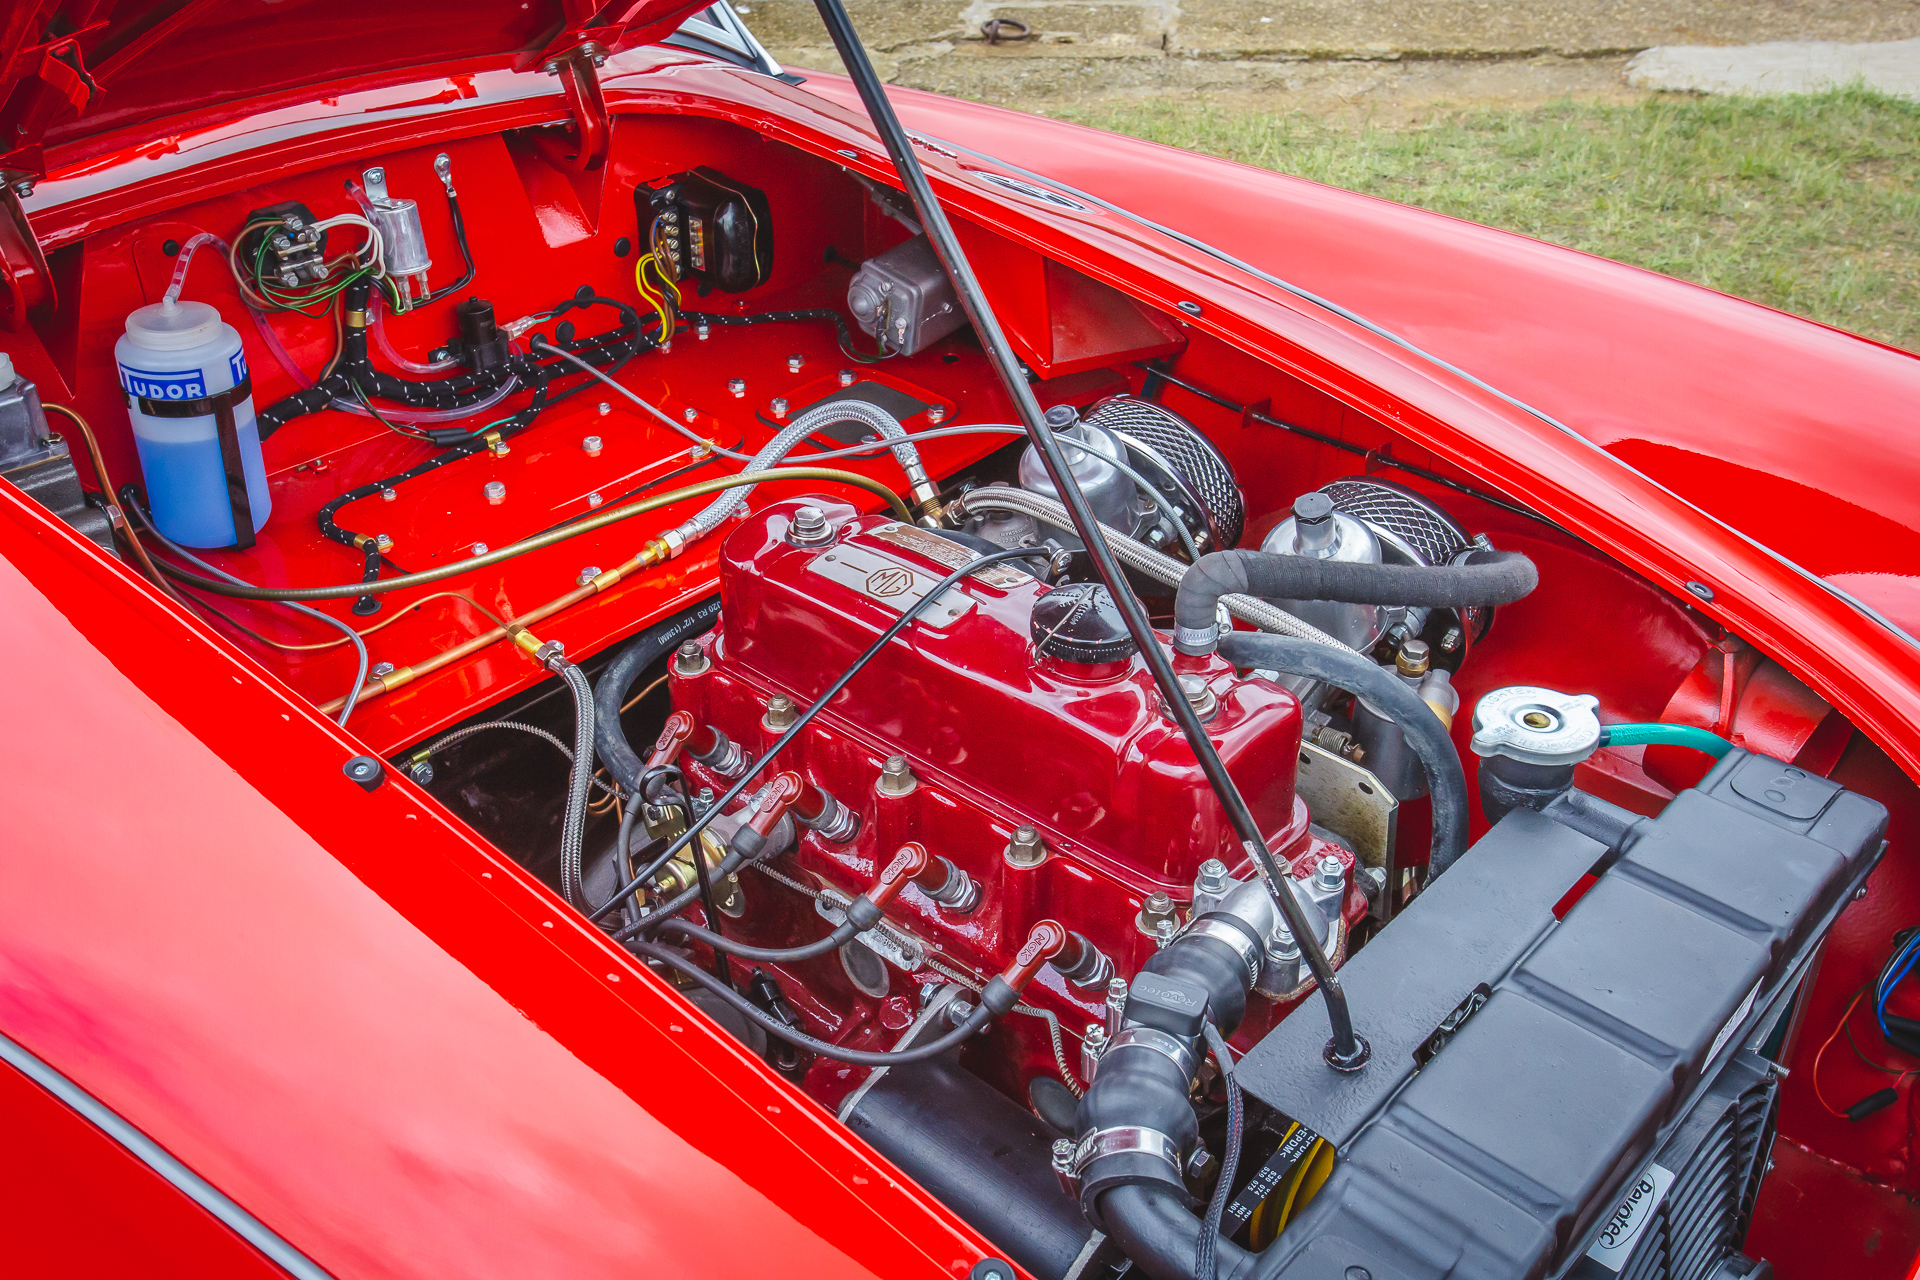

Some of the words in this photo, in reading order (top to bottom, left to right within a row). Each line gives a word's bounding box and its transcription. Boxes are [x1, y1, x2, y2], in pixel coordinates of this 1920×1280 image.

[120, 366, 203, 399] TUDOR
[870, 570, 909, 595] MG
[697, 609, 709, 619] R3
[657, 624, 682, 646] (13MM)
[1481, 687, 1537, 708] TIGHTEN
[658, 721, 678, 746] NGK
[764, 782, 785, 807] NGK
[884, 853, 908, 880] NGK
[657, 901, 679, 915] COPPER
[624, 913, 656, 933] CONDUCTOR
[1020, 932, 1046, 962] NGK
[1138, 985, 1198, 1007] Revotec
[776, 1022, 811, 1041] CONDUCTOR
[812, 1039, 836, 1050] COPPER
[1600, 1179, 1653, 1246] Revotec
